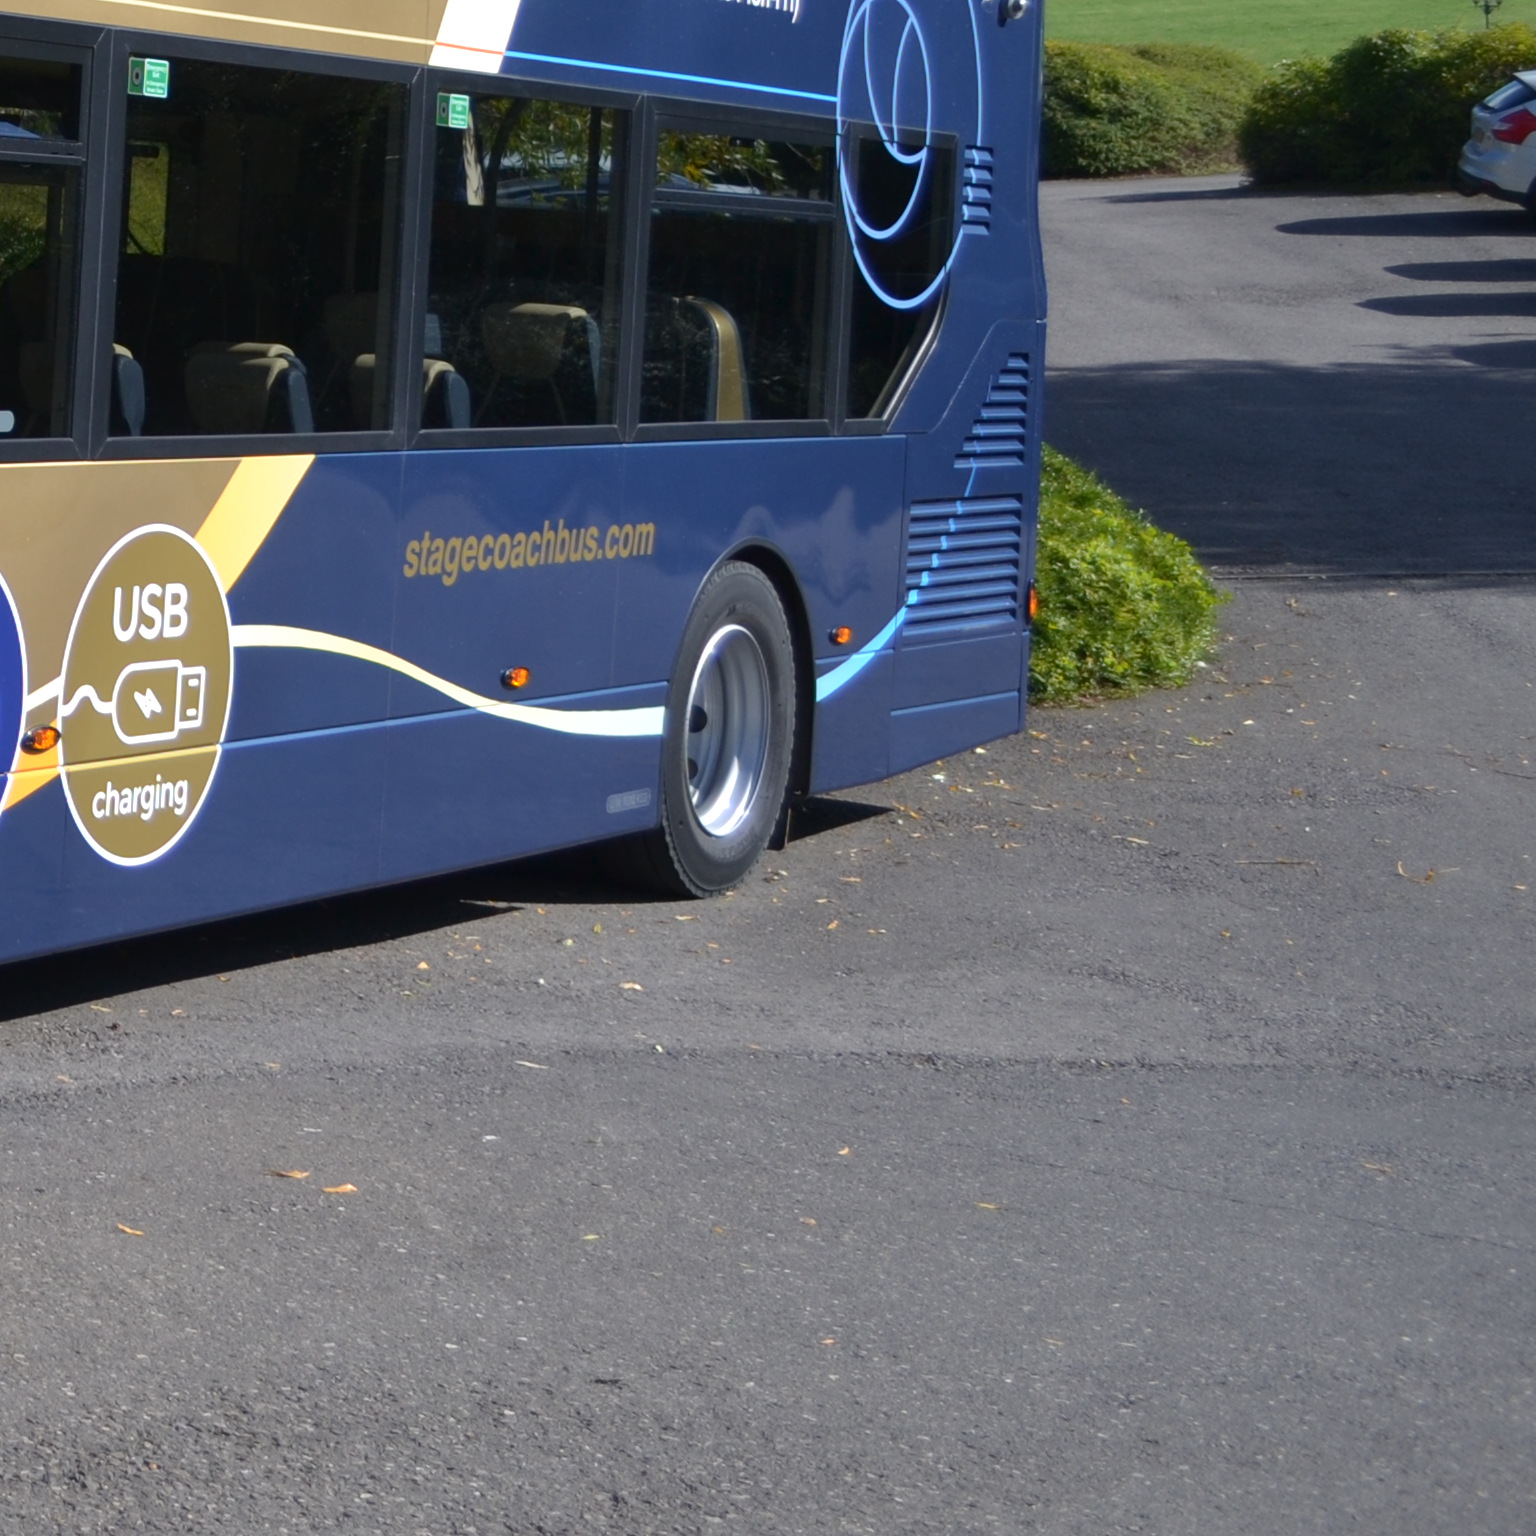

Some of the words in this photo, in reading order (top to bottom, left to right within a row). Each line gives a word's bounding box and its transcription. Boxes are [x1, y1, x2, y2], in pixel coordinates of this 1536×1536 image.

[403, 518, 656, 587] stagecoachbus.com
[112, 582, 188, 642] USB
[91, 774, 188, 821] charging
